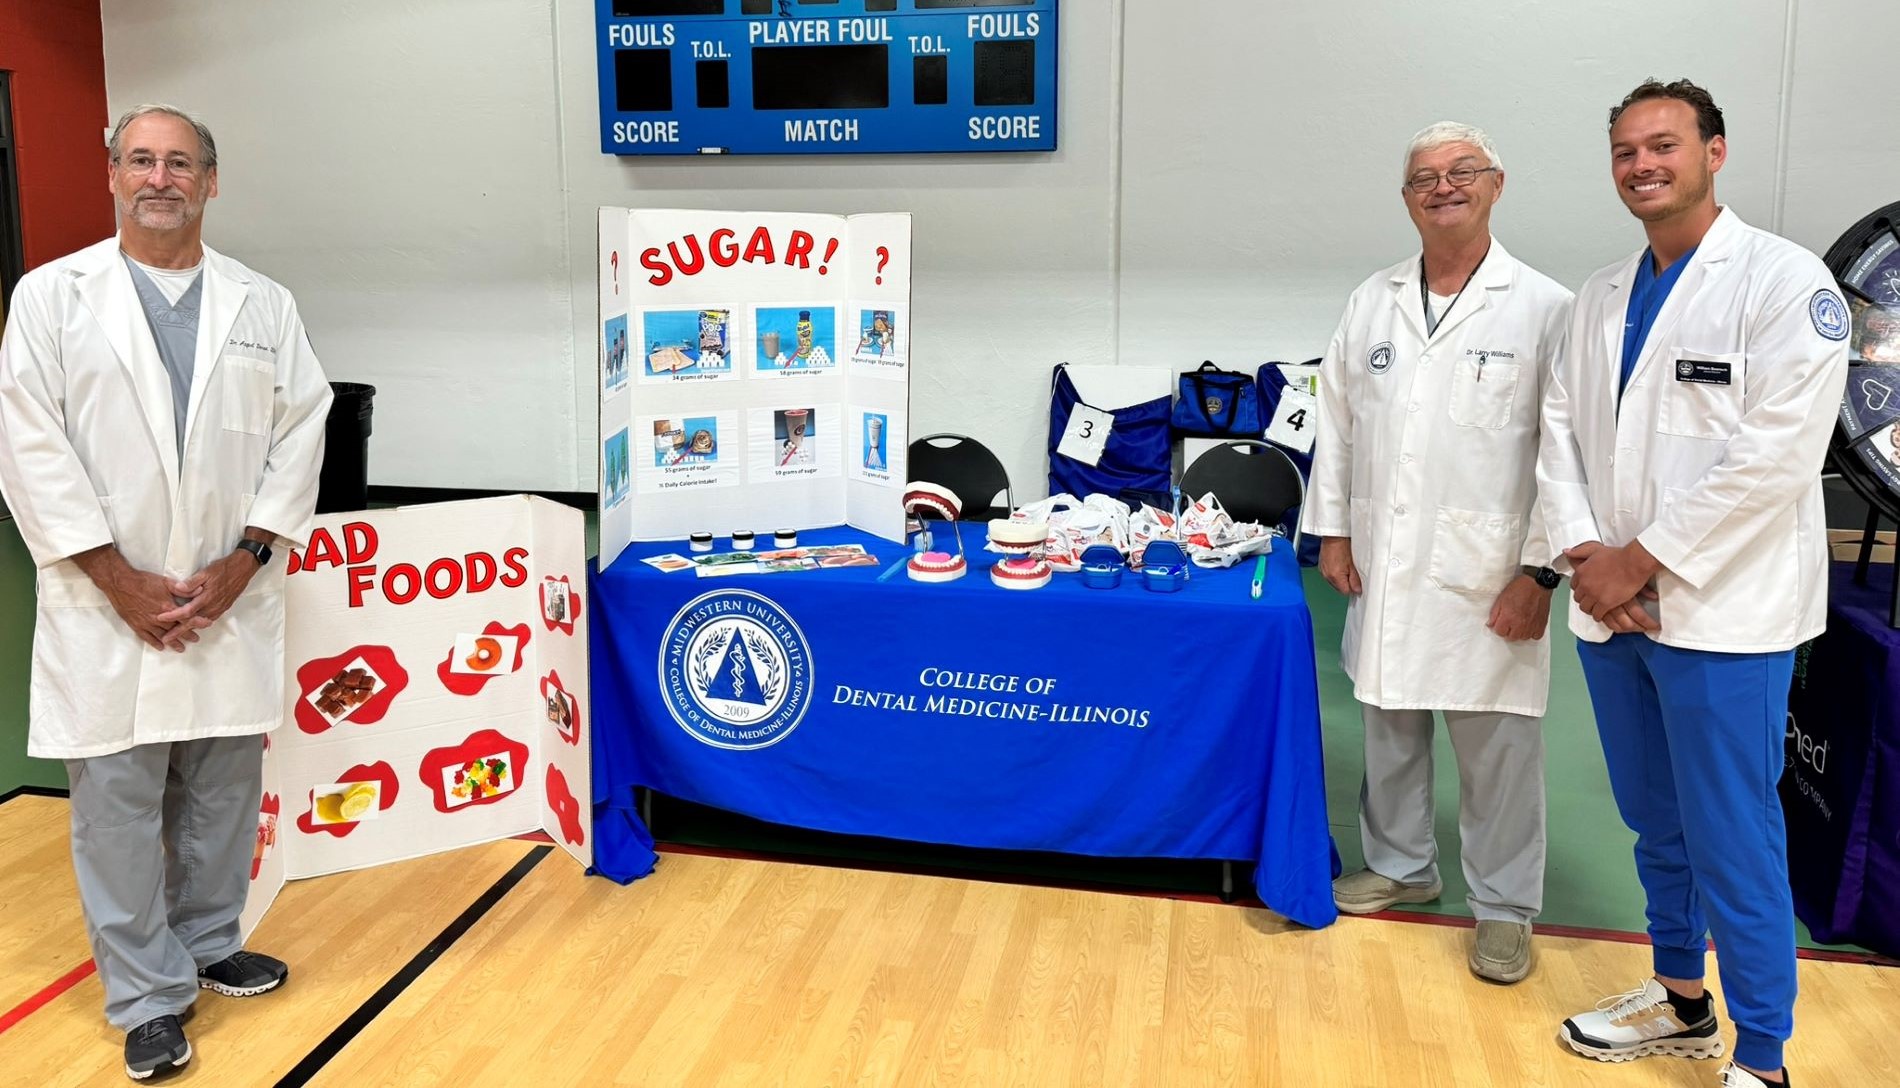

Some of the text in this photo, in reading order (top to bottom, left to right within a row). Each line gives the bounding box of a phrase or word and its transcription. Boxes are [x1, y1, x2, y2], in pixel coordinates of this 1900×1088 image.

[608, 23, 675, 46] FOULS
[749, 17, 893, 45] PLAYER FOUL
[967, 13, 1040, 39] FOULS
[691, 41, 731, 59] T.O.L.
[908, 35, 950, 54] T.O.L.
[613, 120, 680, 144] SCORE
[784, 118, 859, 142] MATCH
[968, 115, 1040, 140] SCORE
[640, 226, 839, 287] SUGAR!
[876, 246, 889, 285] ?
[1474, 349, 1490, 358] Larry
[1490, 350, 1515, 359] Williams
[1079, 419, 1094, 439] 3
[1286, 408, 1307, 432] 4
[696, 464, 711, 472] sugar
[347, 547, 529, 608] FOODS
[671, 600, 803, 671] MIDWESTERN UNIVERSITY
[1025, 676, 1058, 697] OF
[670, 667, 690, 712] COLLEGE
[687, 710, 701, 723] OF
[699, 718, 737, 739] DENTAL
[723, 704, 750, 718] 2009
[832, 685, 918, 713] DENTAL
